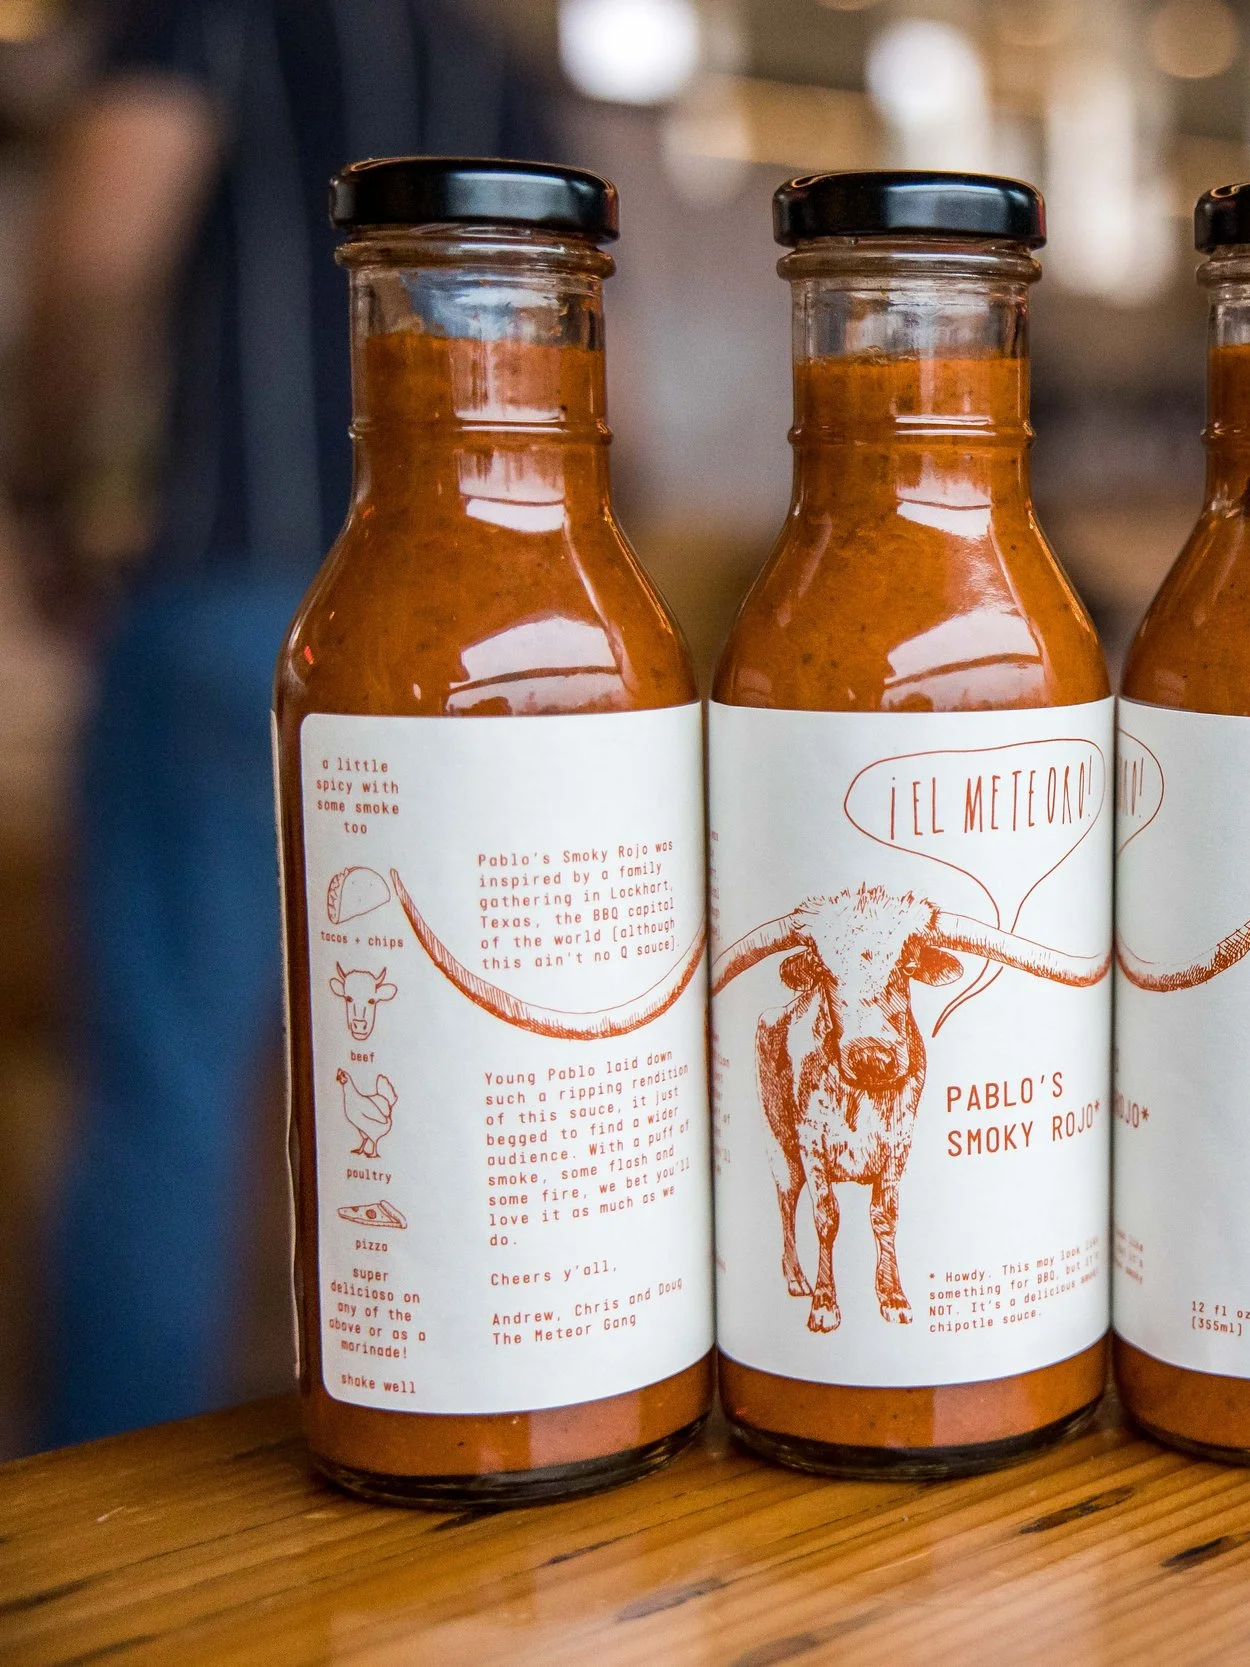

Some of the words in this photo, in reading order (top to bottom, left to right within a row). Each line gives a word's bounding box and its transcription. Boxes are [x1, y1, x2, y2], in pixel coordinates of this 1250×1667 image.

[337, 756, 388, 773] little
[316, 778, 352, 795] spicy
[361, 780, 399, 794] with
[964, 755, 1092, 833] METEORO!
[317, 800, 345, 812] some
[355, 802, 399, 815] smoke
[344, 821, 367, 834] too
[477, 852, 550, 867] Pablo's
[563, 849, 608, 864] Smoky
[618, 843, 648, 859] Rojo
[655, 841, 673, 853] was
[480, 872, 561, 890] inspired
[573, 870, 590, 885] by
[620, 861, 661, 878] family
[479, 893, 572, 912] gathering
[584, 889, 600, 902] in
[611, 880, 673, 899] Lockhart,
[480, 915, 539, 929] Texas,
[555, 912, 581, 925] the
[593, 906, 618, 921] BBQ
[628, 897, 674, 918] capital
[320, 930, 348, 944] tacos
[367, 935, 403, 950] chips
[480, 936, 499, 950] of
[513, 935, 542, 948] the
[554, 929, 601, 946] world
[482, 956, 521, 970] this
[535, 952, 582, 968] ain't
[594, 951, 610, 962] no
[350, 1050, 374, 1062] beef
[485, 1072, 535, 1086] Young
[548, 1065, 595, 1081] Pablo
[607, 1056, 638, 1074] laid
[647, 1051, 672, 1066] down
[485, 1091, 525, 1106] such
[559, 1082, 622, 1101] ripping
[632, 1064, 688, 1088] rendition
[947, 1072, 1063, 1113] PABLO'S
[486, 1112, 504, 1126] of
[518, 1109, 557, 1124] this
[570, 1104, 621, 1119] sauce,
[633, 1096, 646, 1109] it
[656, 1086, 678, 1106] just
[486, 1130, 547, 1148] begged
[560, 1128, 577, 1140] to
[590, 1119, 623, 1136] find
[647, 1107, 678, 1125] wider
[947, 1121, 1033, 1157] SMOKY
[487, 1150, 575, 1166] audience.
[589, 1139, 623, 1156] With
[648, 1124, 673, 1147] puff
[346, 1168, 391, 1184] poultry
[488, 1172, 546, 1186] smoke,
[561, 1166, 597, 1180] some
[609, 1153, 647, 1172] flash
[656, 1144, 674, 1161] and
[489, 1194, 528, 1206] some
[542, 1188, 586, 1202] fire,
[599, 1183, 615, 1194] we
[626, 1174, 647, 1189] bet
[656, 1157, 690, 1184] you'll
[490, 1213, 528, 1227] love
[542, 1209, 559, 1223] it
[572, 1207, 589, 1218] as
[599, 1196, 633, 1214] much
[355, 1238, 388, 1252] pizza
[489, 1234, 516, 1246] do.
[352, 1268, 388, 1283] super
[491, 1272, 551, 1286] Cheers
[564, 1260, 616, 1282] y'all,
[945, 1269, 991, 1283] Howdy.
[1002, 1262, 1029, 1275] This
[330, 1280, 394, 1301] delicioso
[403, 1293, 420, 1303] on
[929, 1285, 1001, 1300] something
[1010, 1279, 1028, 1290] for
[337, 1302, 357, 1317] any
[365, 1306, 378, 1318] of
[388, 1308, 411, 1322] the
[492, 1312, 560, 1326] Andrew,
[575, 1299, 619, 1317] Chris
[629, 1288, 651, 1305] and
[658, 1278, 682, 1296] Doug
[971, 1300, 1001, 1313] It's
[1192, 1301, 1205, 1313] 12
[1214, 1304, 1227, 1316] fl
[329, 1317, 361, 1334] above
[368, 1327, 382, 1337] or
[392, 1330, 408, 1340] as
[493, 1332, 522, 1345] The
[535, 1325, 591, 1342] Meteor
[603, 1314, 636, 1331] Gang
[929, 1317, 993, 1333] chipotle
[1003, 1309, 1041, 1324] sauce.
[1191, 1316, 1242, 1336] [355ml]
[340, 1339, 406, 1358] marinade!
[341, 1373, 375, 1389] shake
[383, 1381, 415, 1394] well
